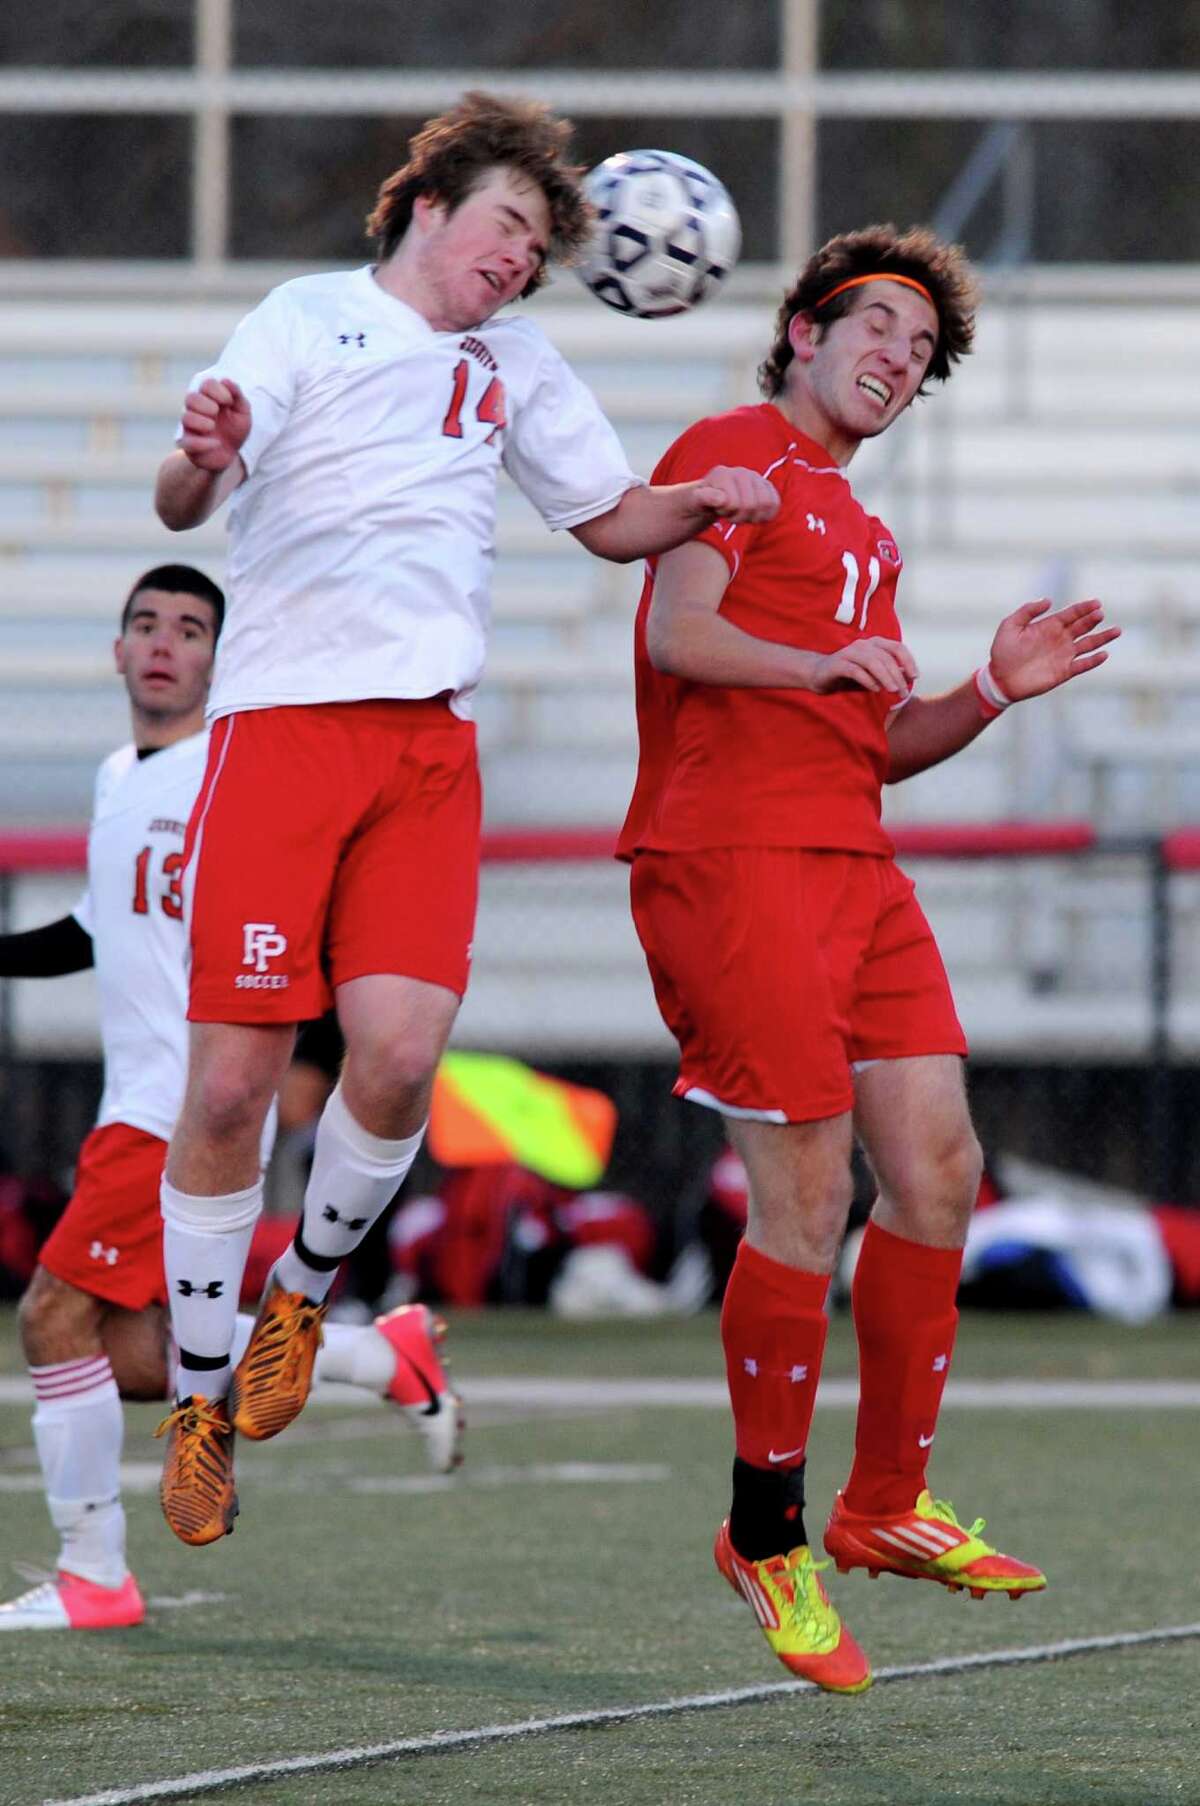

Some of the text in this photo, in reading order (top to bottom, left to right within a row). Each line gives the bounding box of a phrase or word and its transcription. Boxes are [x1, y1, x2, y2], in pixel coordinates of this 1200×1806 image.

[441, 358, 507, 447] 14
[834, 550, 880, 631] 11
[132, 846, 185, 922] 13
[242, 922, 288, 973] FP
